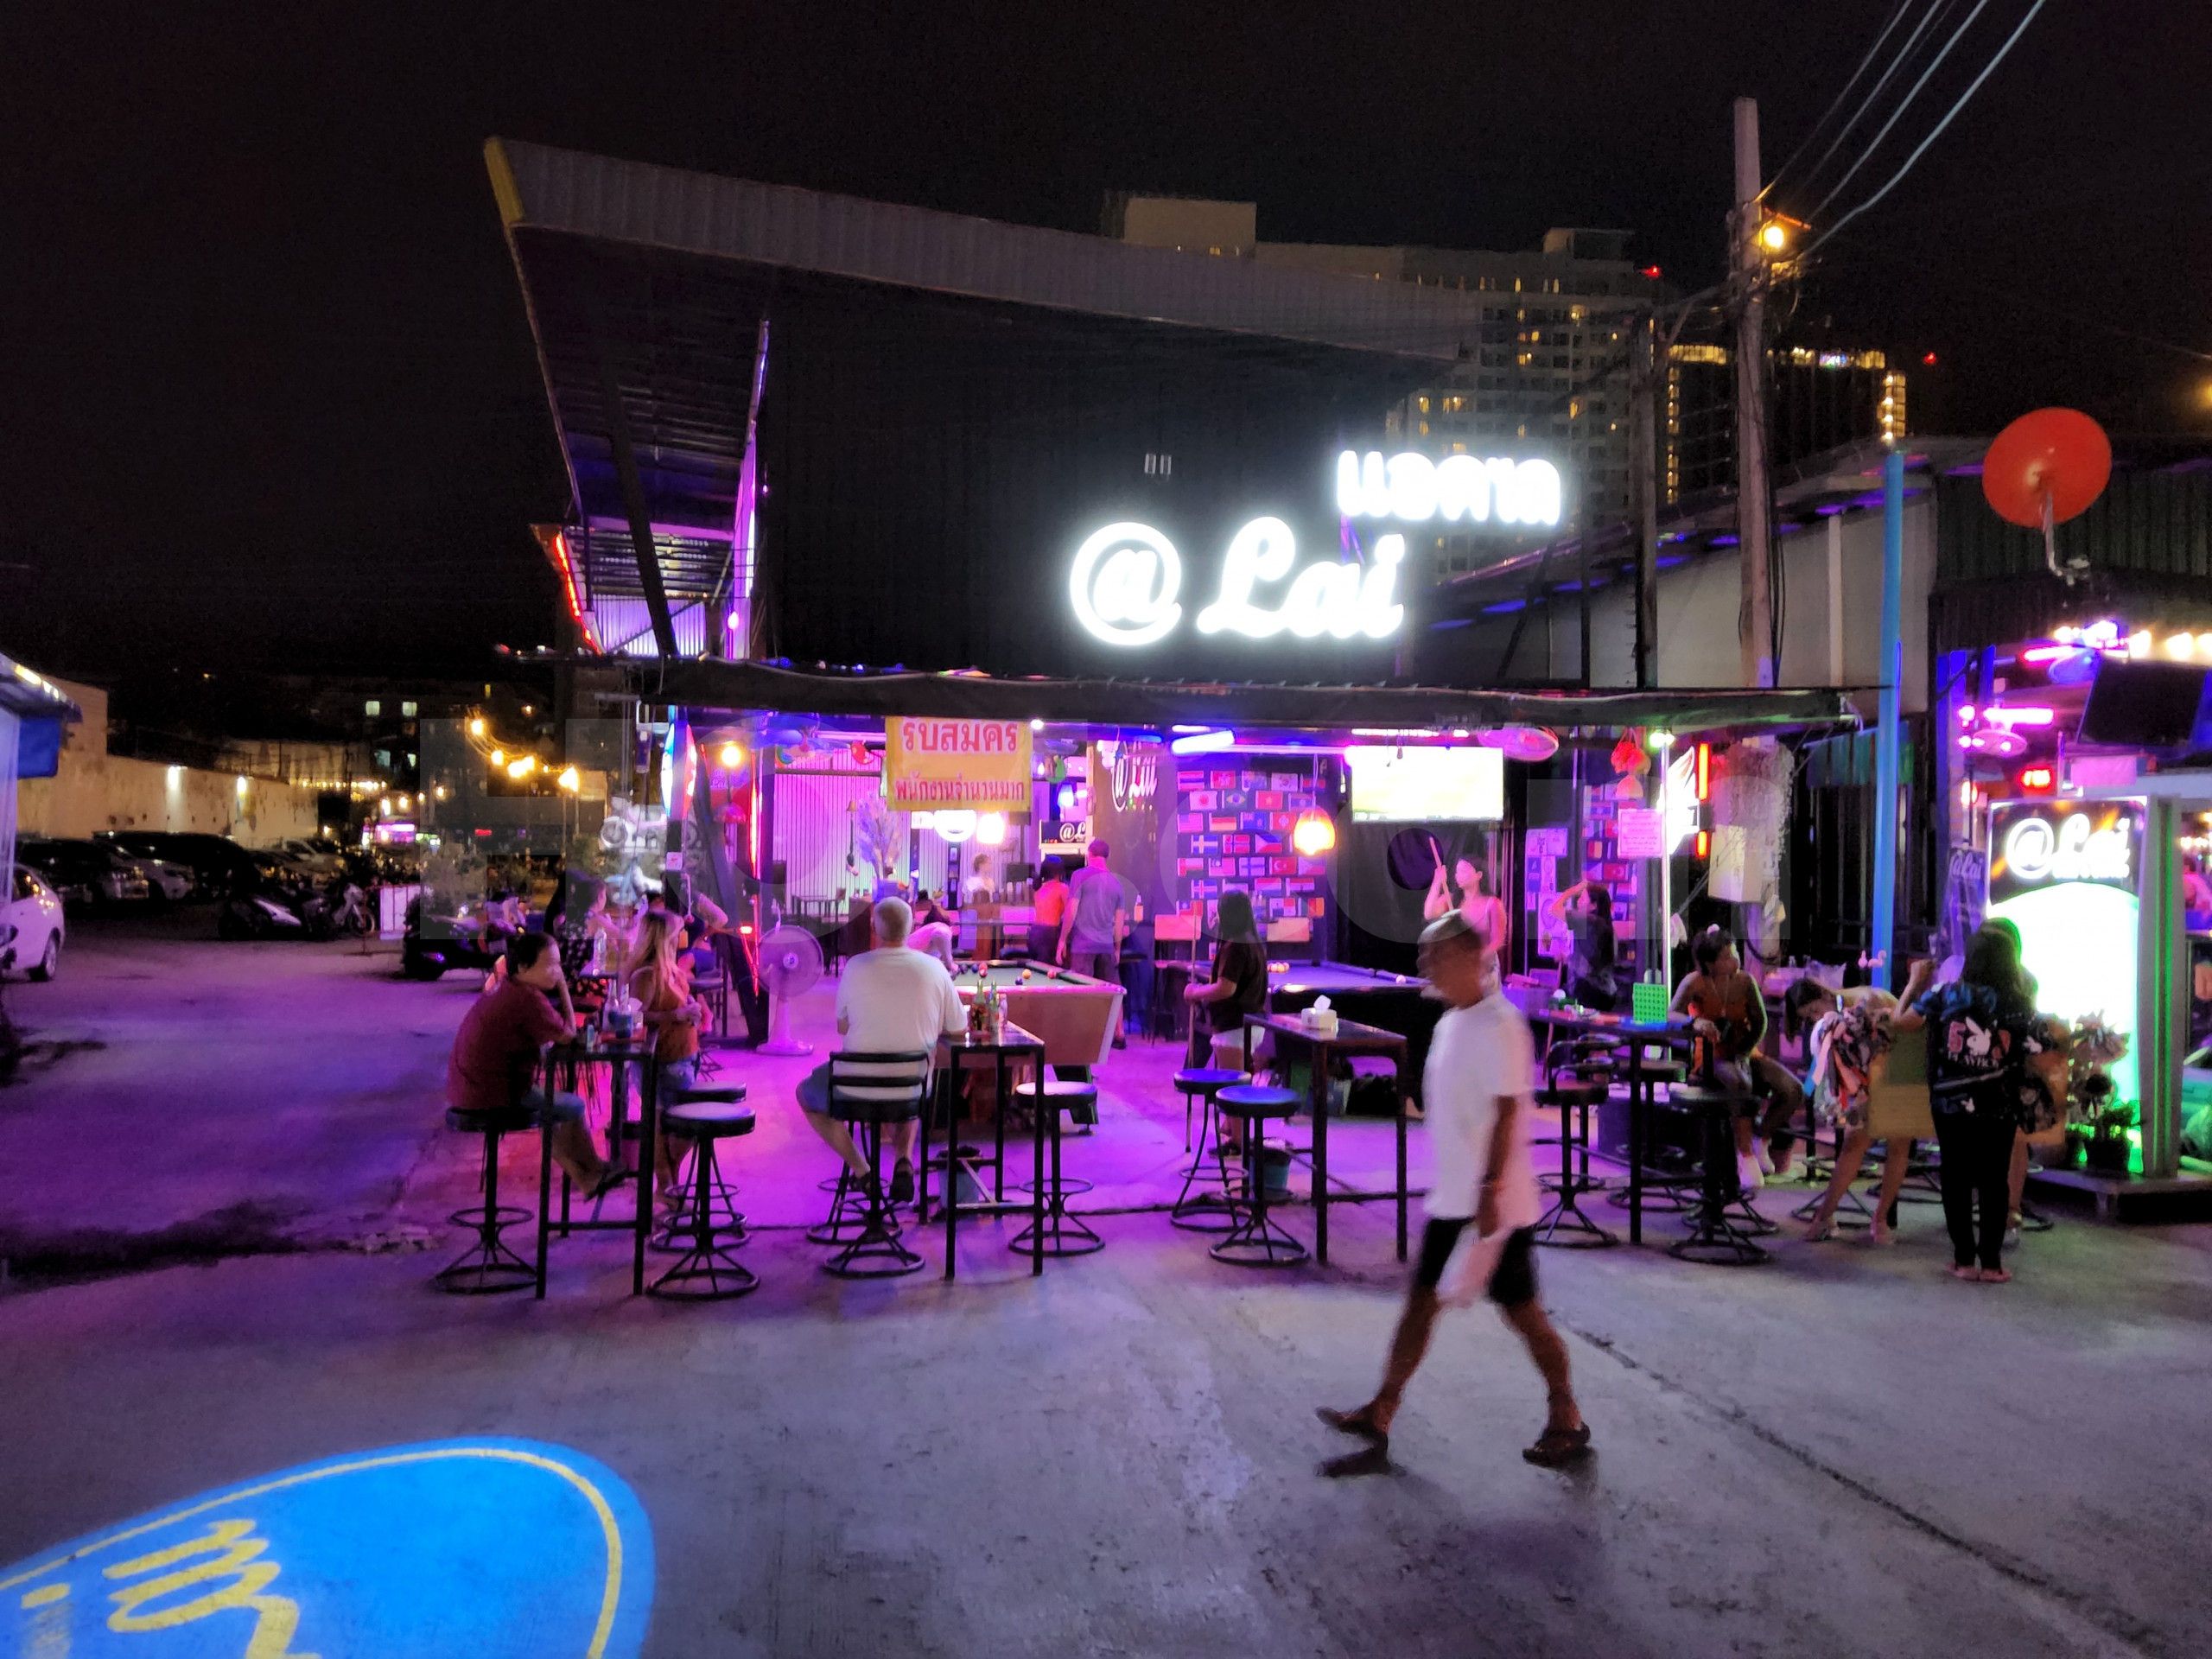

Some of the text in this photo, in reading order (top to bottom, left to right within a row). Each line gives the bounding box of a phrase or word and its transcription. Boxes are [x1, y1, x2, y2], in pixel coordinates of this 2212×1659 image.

[903, 719, 1018, 752] รบสมคร
[895, 772, 1025, 803] พนักงานจำนวนมาก
